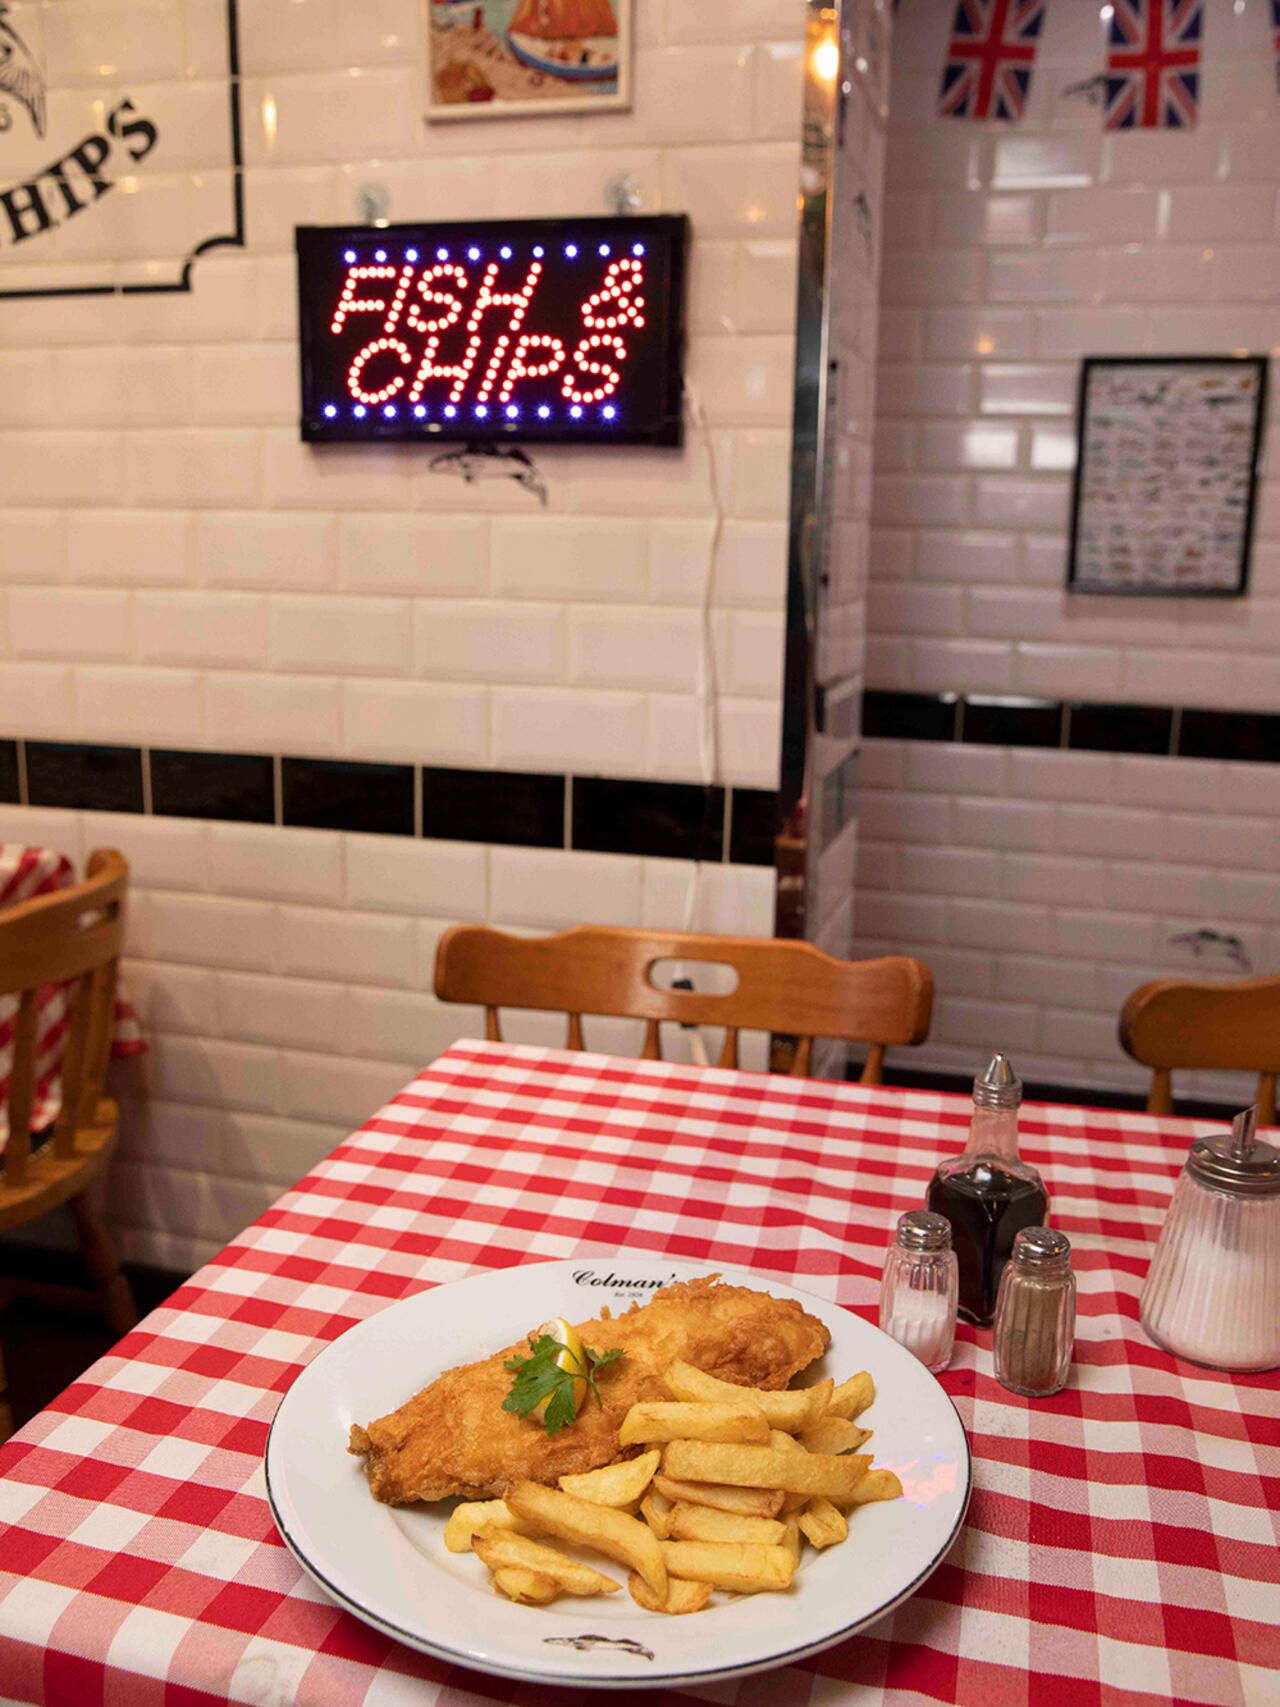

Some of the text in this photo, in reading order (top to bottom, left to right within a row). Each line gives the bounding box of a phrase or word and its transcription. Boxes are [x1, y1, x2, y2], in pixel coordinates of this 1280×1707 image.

[0, 97, 159, 243] HIPS
[331, 258, 645, 334] FISH &
[347, 333, 627, 404] CHIPS
[572, 1269, 678, 1289] Colman'
